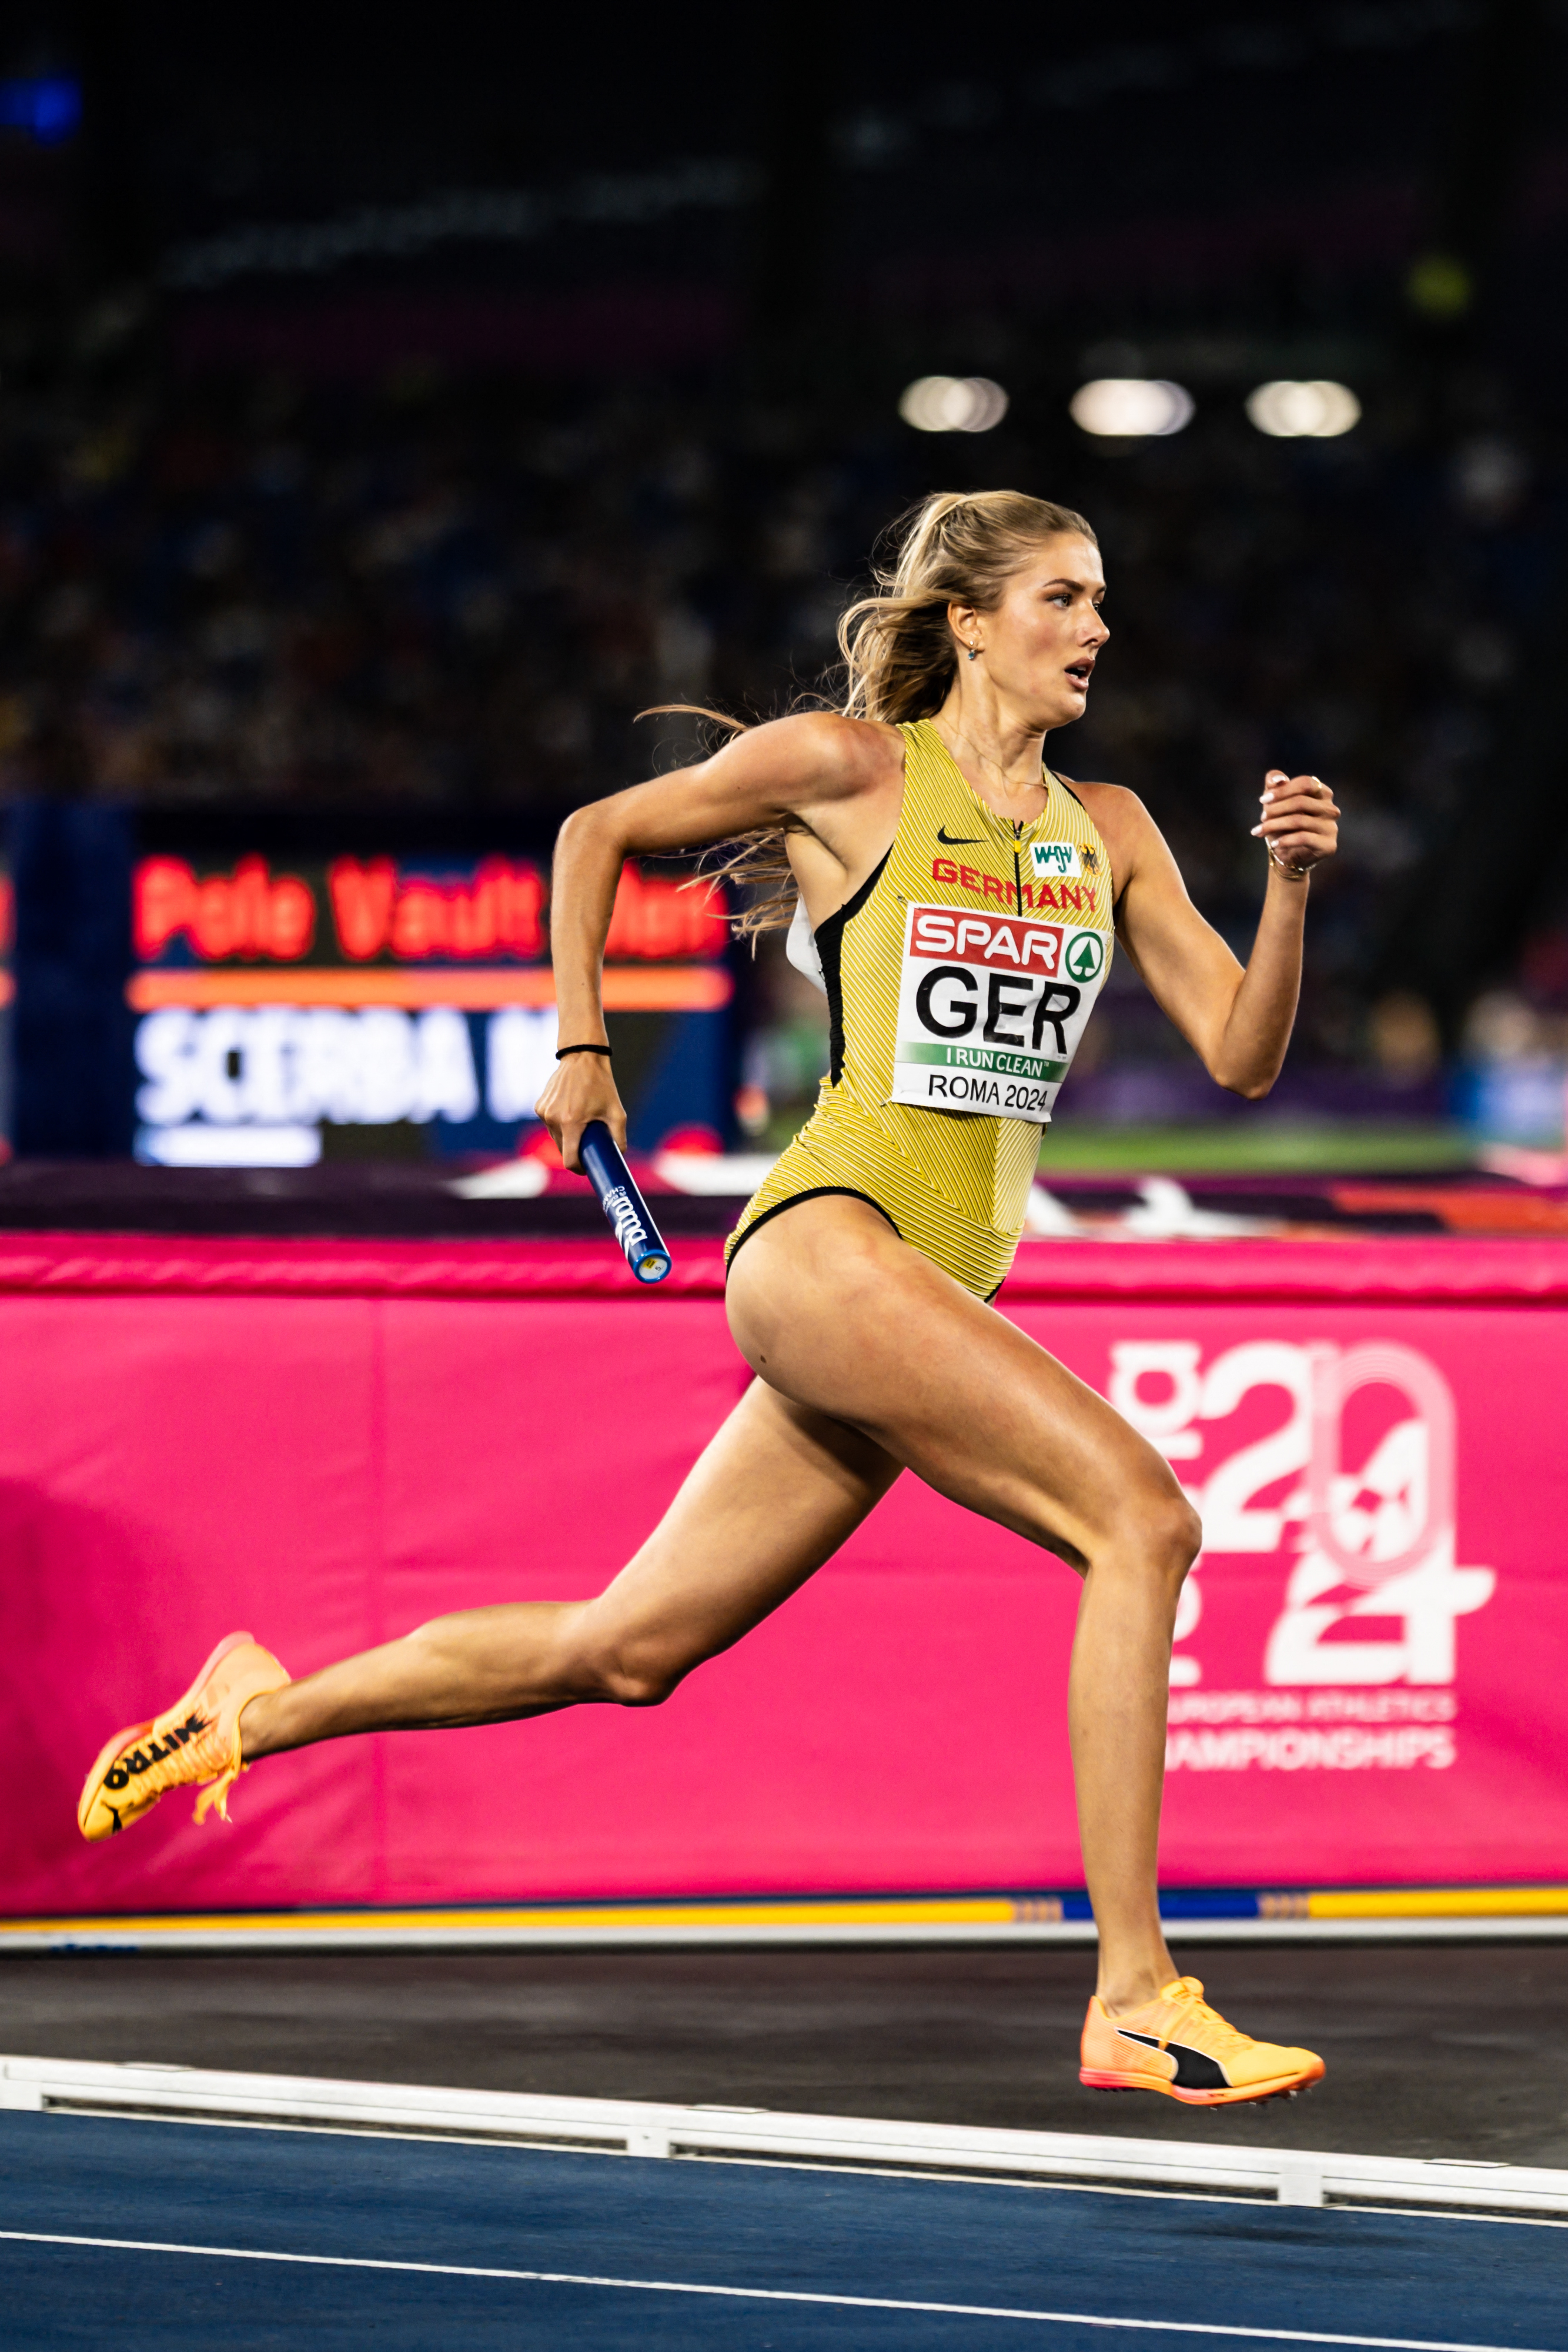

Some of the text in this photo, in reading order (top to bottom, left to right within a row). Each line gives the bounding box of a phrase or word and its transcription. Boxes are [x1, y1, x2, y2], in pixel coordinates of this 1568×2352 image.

[932, 858, 1096, 912] GERMANY
[915, 915, 1059, 970] SPAR
[915, 965, 1081, 1055] GER
[947, 1047, 951, 1064] I
[956, 1048, 994, 1069] RUN
[928, 1074, 1048, 1111] ROMA 2024
[612, 1195, 648, 1247] roma
[103, 1712, 212, 1790] NITRO
